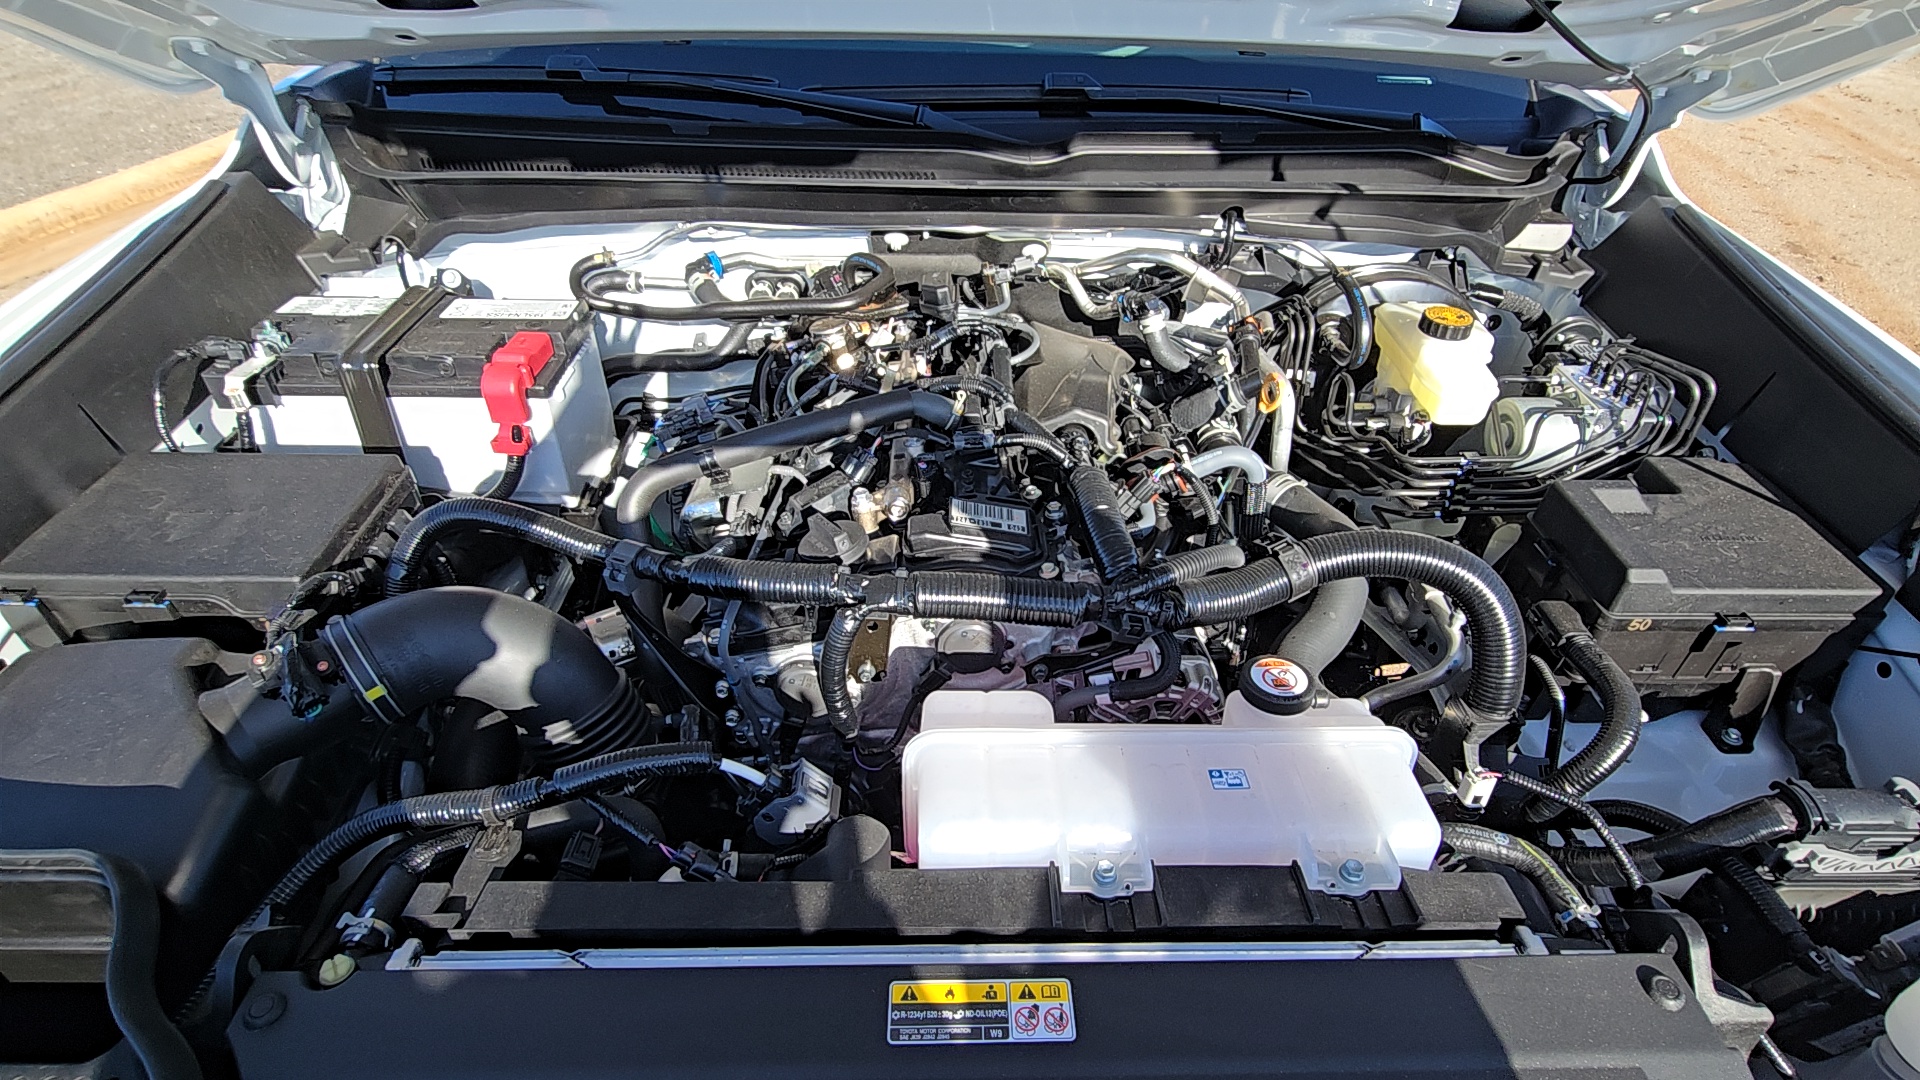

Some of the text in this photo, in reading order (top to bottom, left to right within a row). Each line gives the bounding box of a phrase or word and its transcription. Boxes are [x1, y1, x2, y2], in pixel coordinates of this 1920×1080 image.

[1627, 618, 1653, 632] 50
[900, 1010, 926, 1020] R-1234yf
[989, 1029, 1003, 1038] W9
